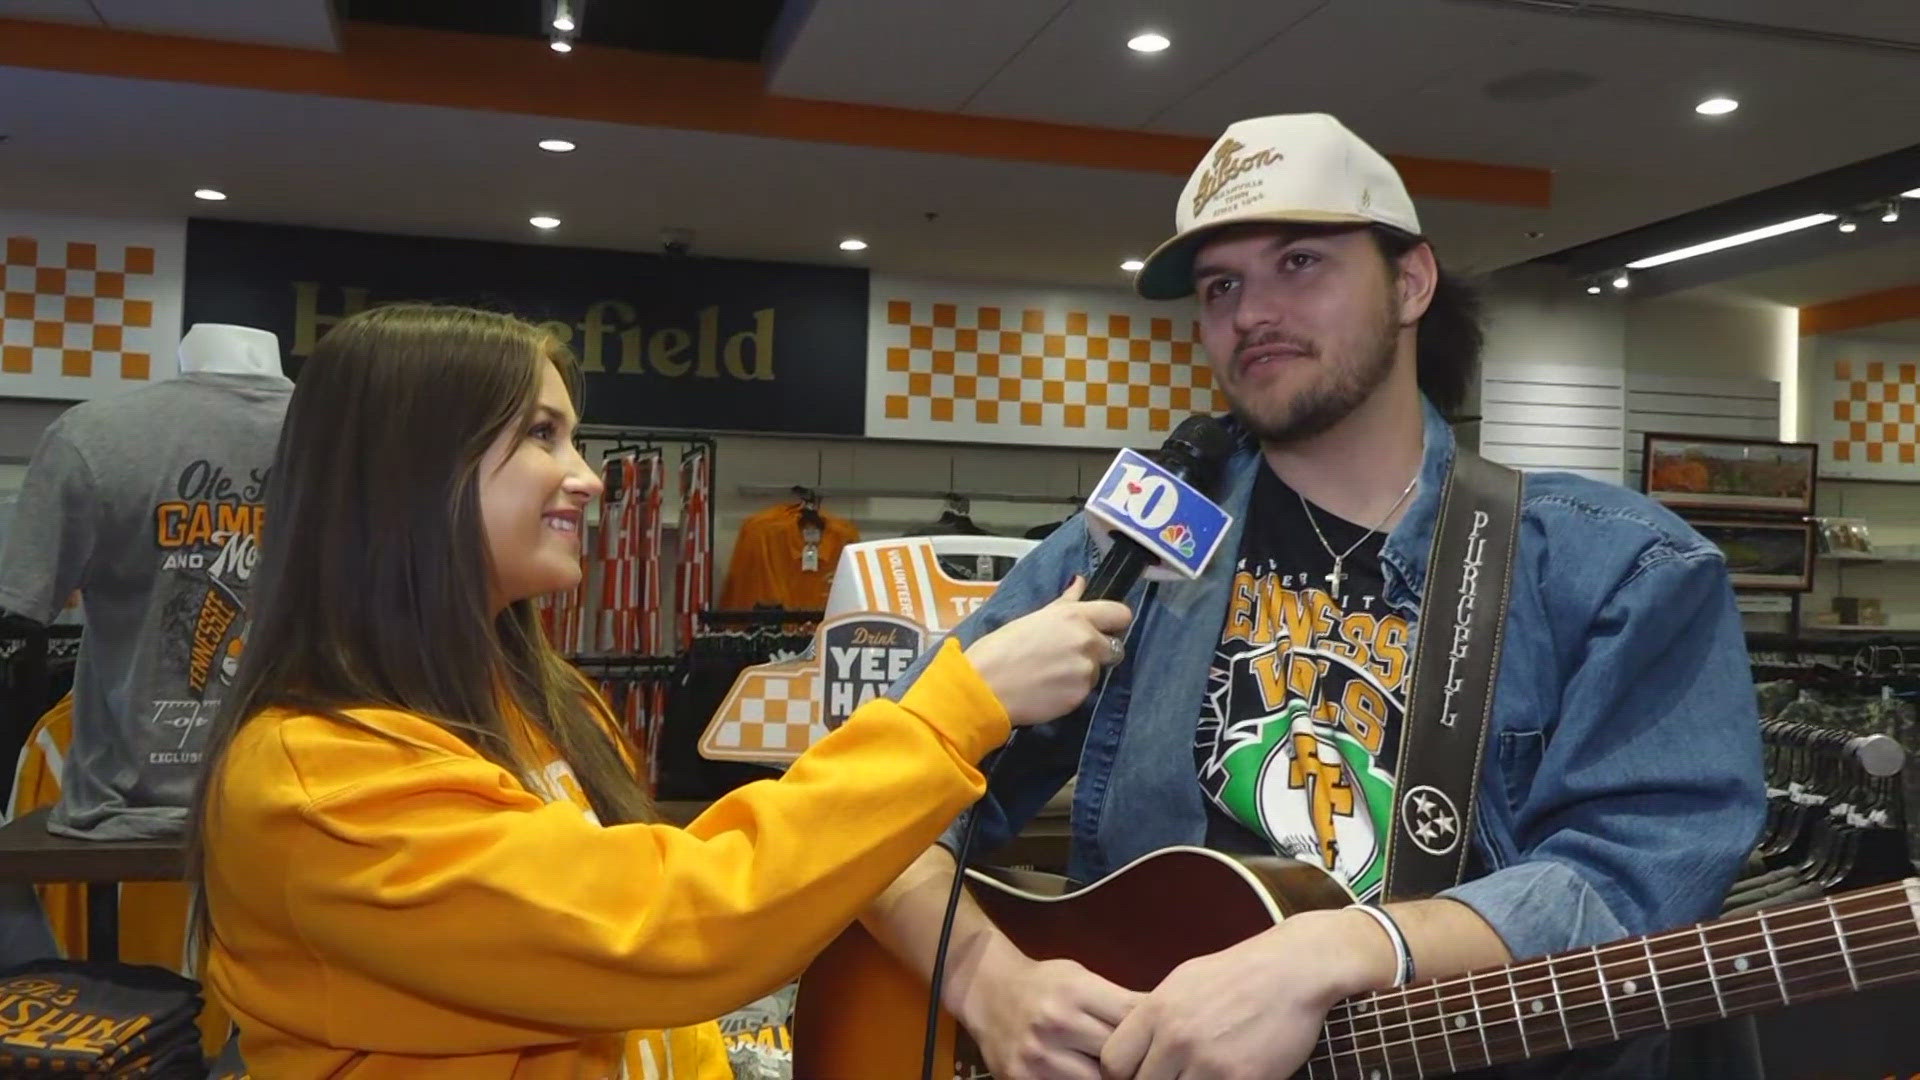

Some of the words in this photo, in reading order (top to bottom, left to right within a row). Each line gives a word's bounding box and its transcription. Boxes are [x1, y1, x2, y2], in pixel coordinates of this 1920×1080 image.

[177, 460, 242, 504] Ole
[1098, 463, 1179, 530] 10
[162, 553, 204, 570] AND
[851, 627, 898, 646] Drink
[1440, 511, 1489, 727] PURCELL
[189, 589, 236, 692] TENNESSEE
[829, 647, 914, 681] YEE
[830, 681, 890, 716] HA
